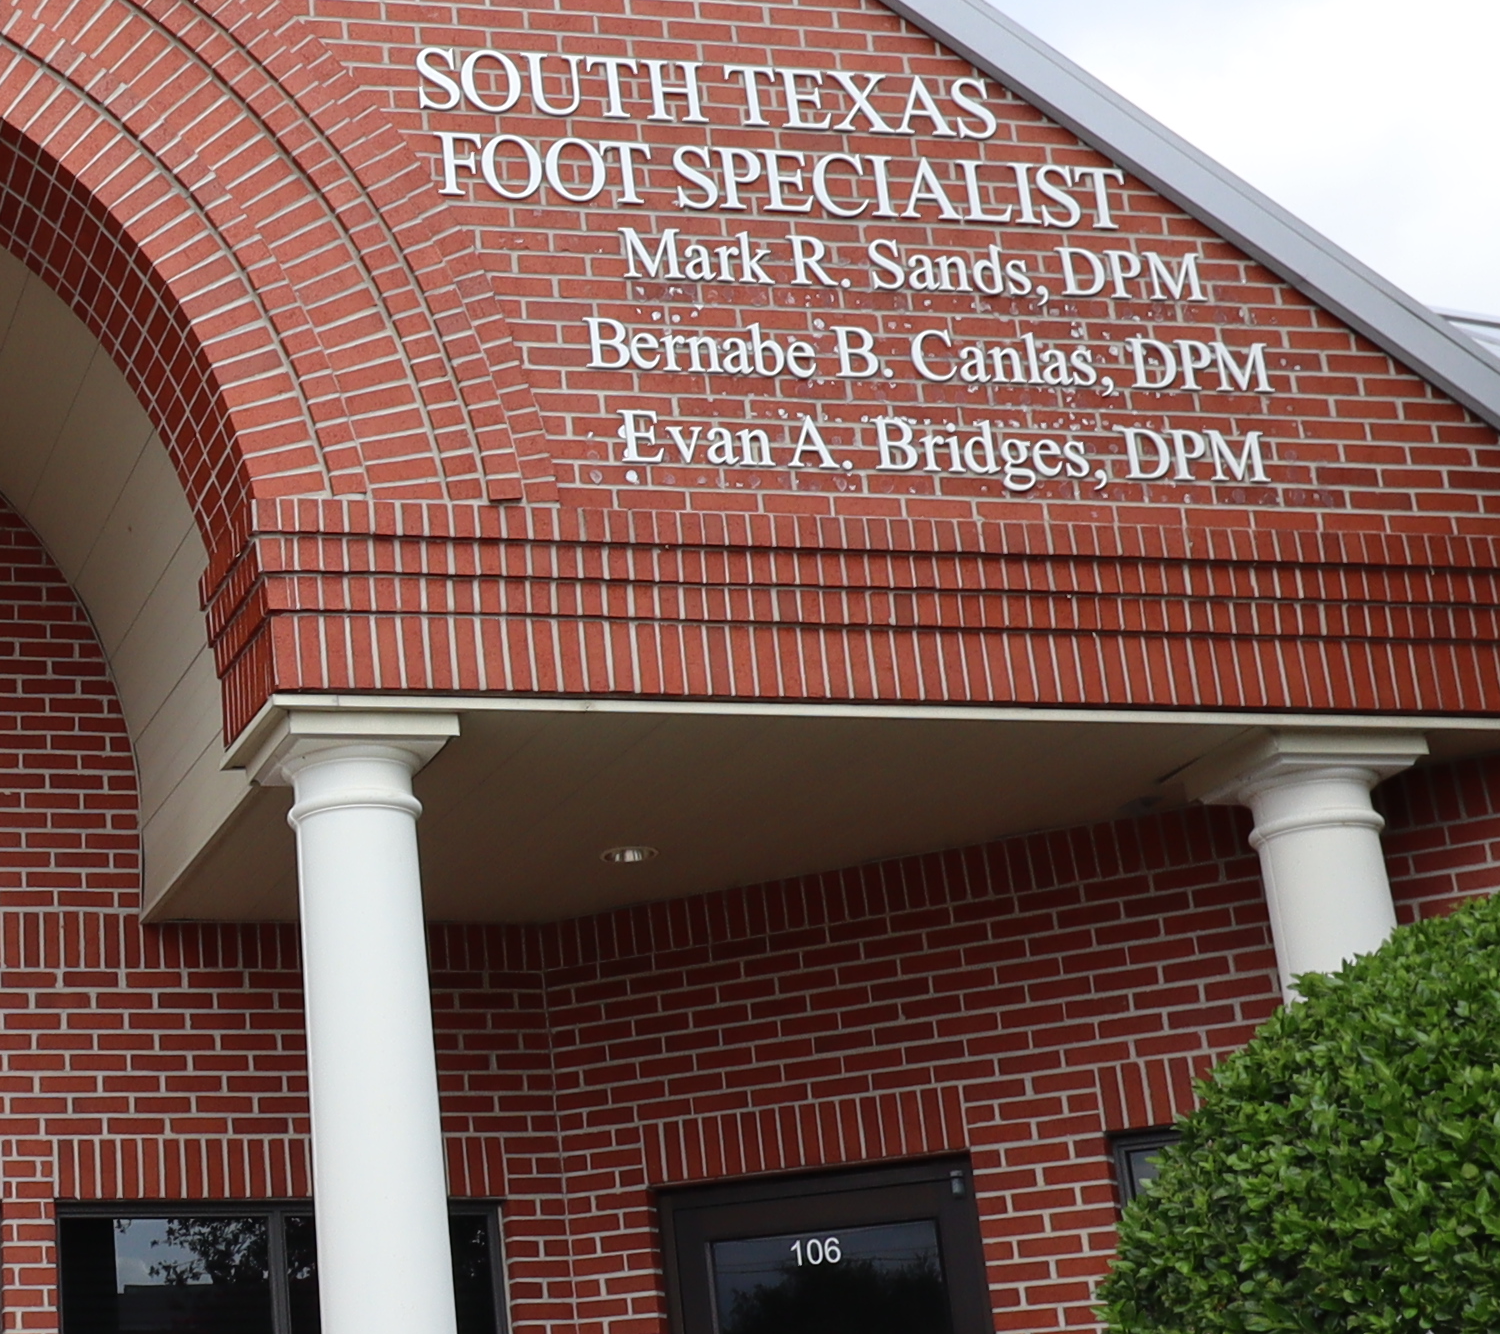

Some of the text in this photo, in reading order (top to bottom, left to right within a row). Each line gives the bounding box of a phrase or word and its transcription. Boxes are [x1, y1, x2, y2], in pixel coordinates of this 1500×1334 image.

[415, 48, 999, 142] SOUTH TEXAS
[433, 131, 1125, 231] FOOT SPECIALIST
[617, 227, 1209, 308] Mark R. Sands, DPM
[583, 317, 1276, 398] Bernabe B. Canlas, DPM
[616, 409, 1273, 494] Evan A. Bridges, DPM
[790, 1236, 842, 1267] 106
